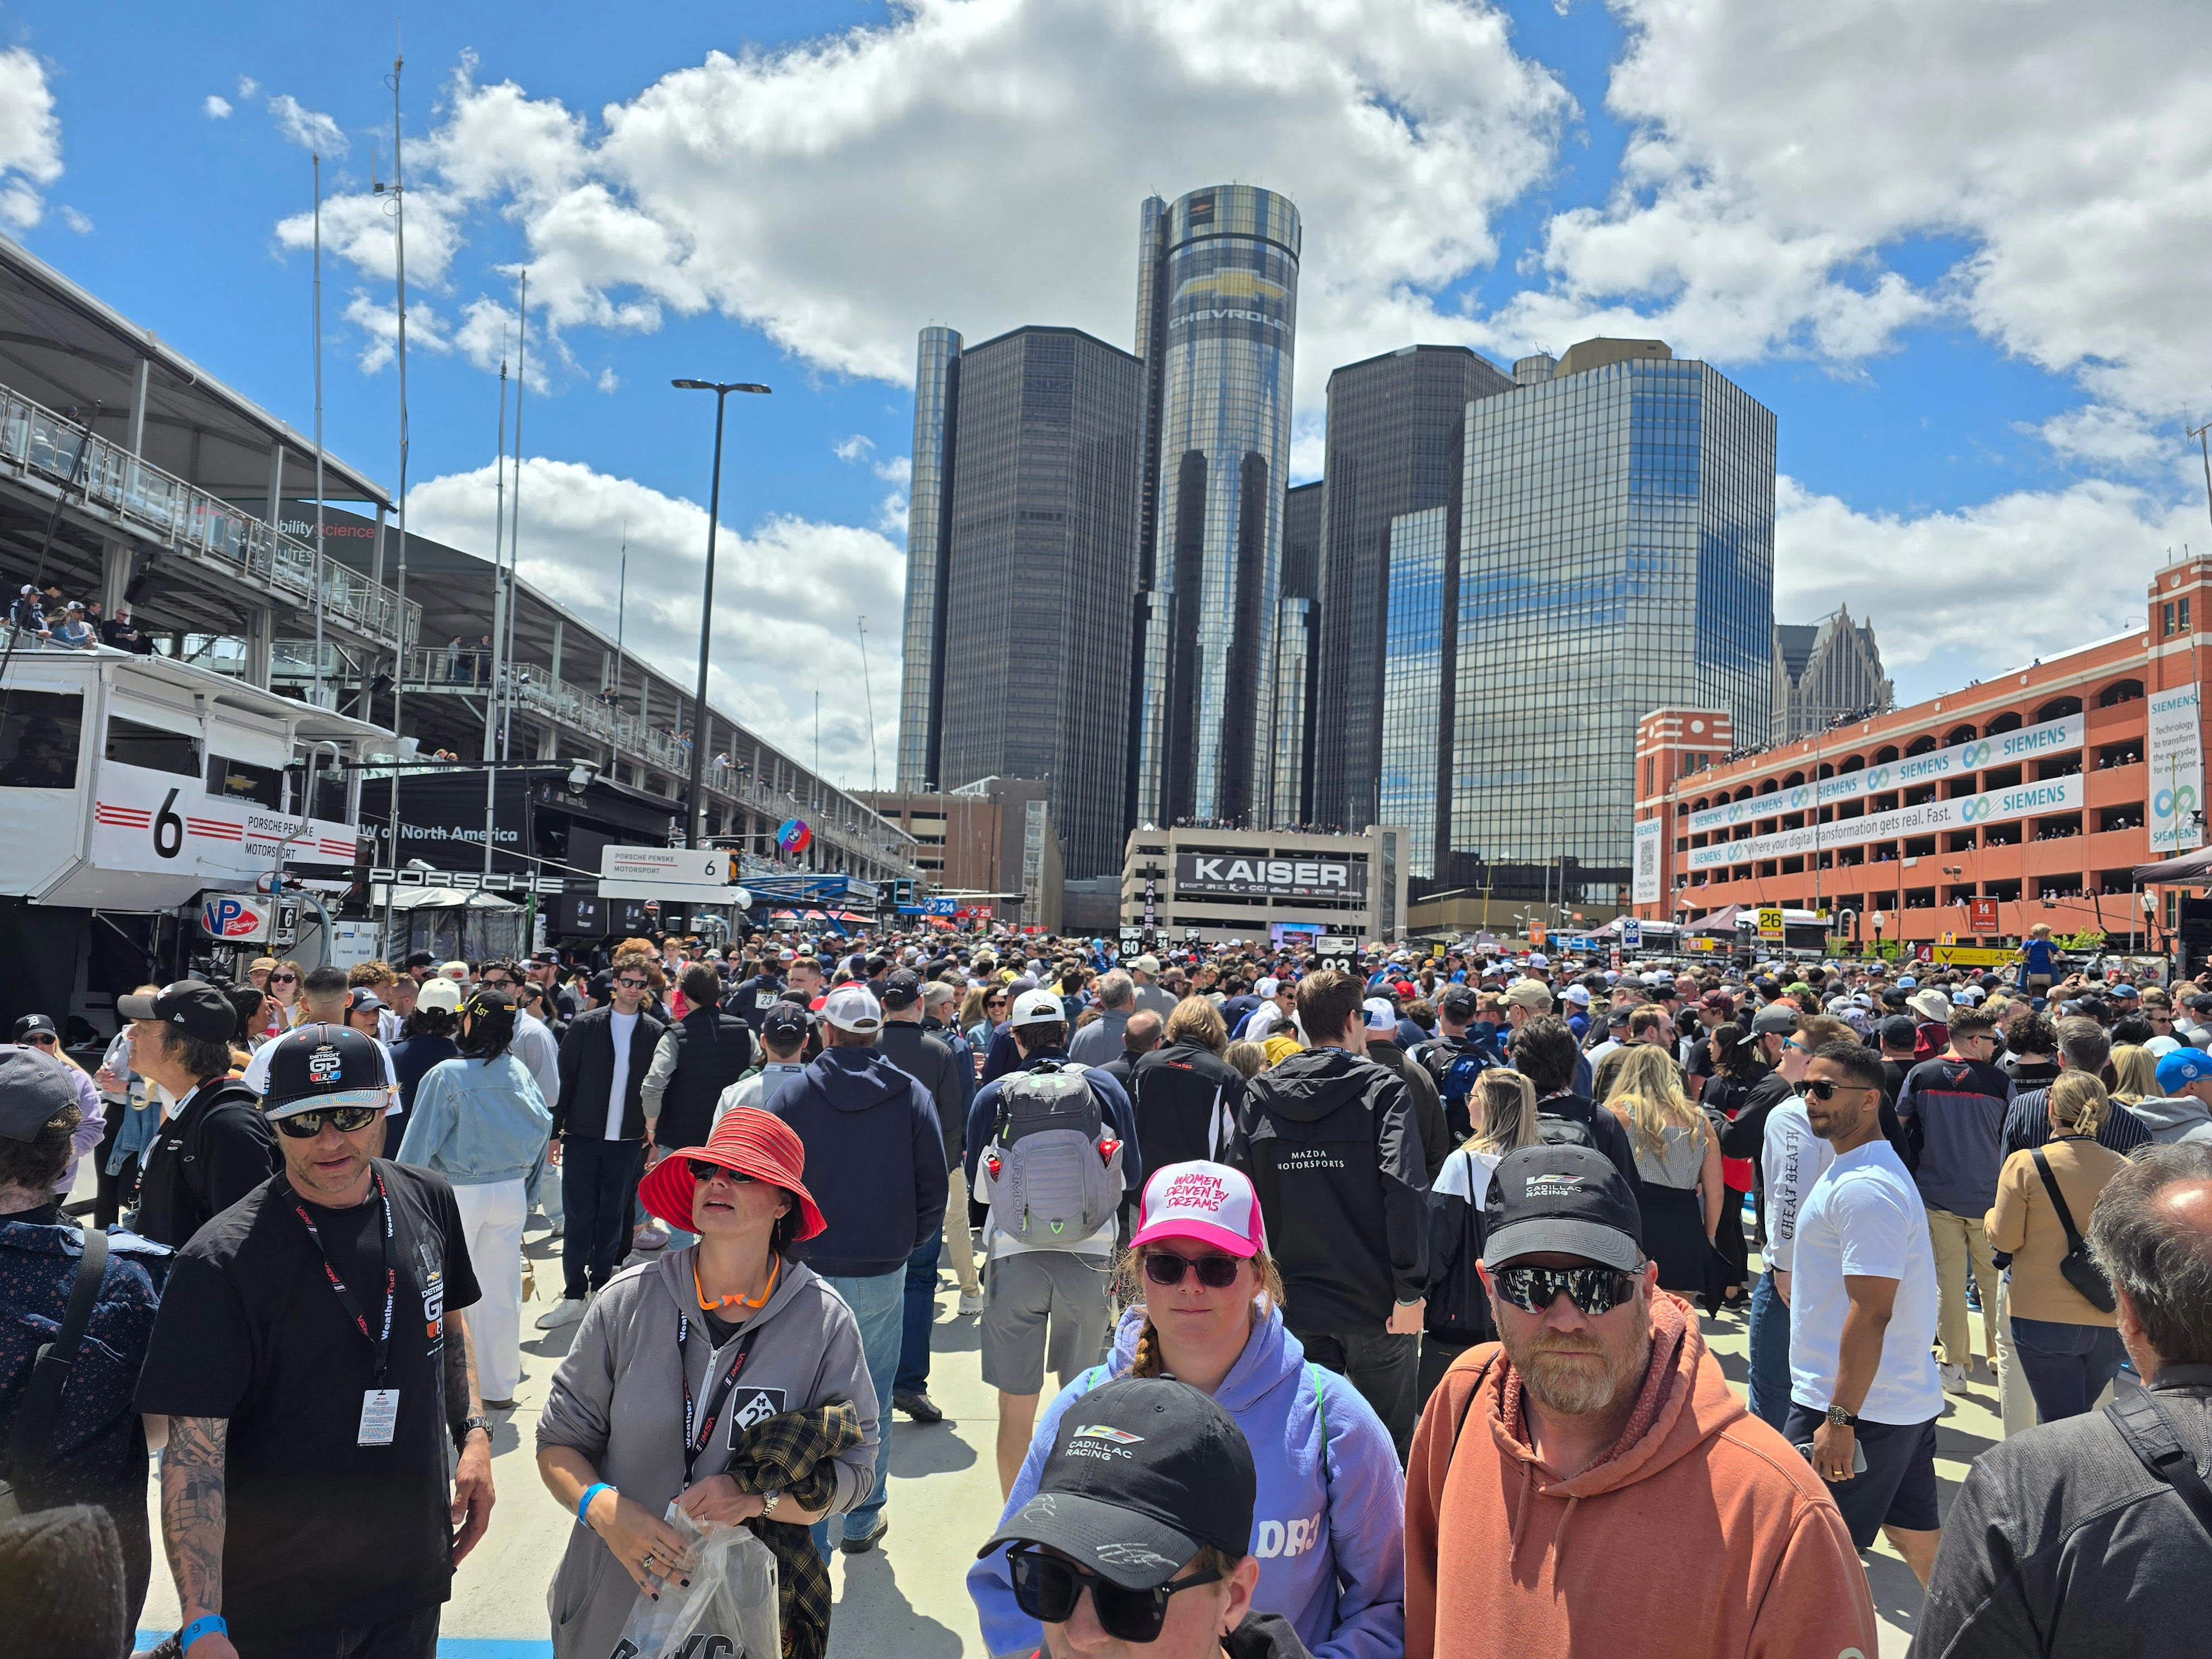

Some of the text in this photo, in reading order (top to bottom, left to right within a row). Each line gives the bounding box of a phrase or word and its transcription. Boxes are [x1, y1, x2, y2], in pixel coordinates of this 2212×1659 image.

[1169, 308, 1291, 335] CHEVROLET
[2152, 693, 2197, 715] SIEMENS
[2156, 720, 2194, 735] Technology
[2003, 726, 2066, 755] SIEMENS
[2154, 732, 2196, 749] to transform
[2153, 752, 2164, 762] the
[1900, 755, 1949, 780] SIEMENS
[2154, 764, 2163, 775] for
[1818, 778, 1857, 799] SIEMENS
[1750, 797, 1783, 815] SIEMENS
[153, 788, 182, 859] 6
[248, 816, 282, 832] PORSCHE
[1695, 811, 1722, 827] SIEMENS
[1695, 850, 1721, 864] SIEMENS
[1746, 841, 1770, 853] Where
[1772, 841, 1787, 854] your
[1789, 830, 1813, 850] digital
[1880, 816, 1900, 835] gets
[1902, 809, 1924, 828] real.
[1927, 806, 1951, 823] Fast.
[2003, 785, 2065, 811] SIEMENS
[401, 825, 447, 840] North
[450, 826, 518, 842] America
[1636, 822, 1659, 836] SIEMENS
[2153, 828, 2198, 843] SIEMENS
[245, 843, 296, 860] MOTORSORT
[614, 865, 661, 874] MOTORSPORT
[705, 860, 715, 875] 6
[1196, 858, 1347, 886] KAISER
[368, 867, 564, 894] PORSCHE
[939, 903, 954, 913] 24
[980, 909, 991, 917] 25
[1144, 880, 1155, 931] KAISER
[1978, 903, 1989, 914] 14
[205, 899, 242, 935] VP
[285, 908, 294, 928] 6
[1760, 913, 1781, 928] 26
[225, 920, 259, 933] Racing
[1625, 928, 1638, 938] 66
[1122, 941, 1139, 954] 60
[1157, 938, 1168, 948] 24
[1689, 940, 1701, 948] 81
[1921, 947, 1930, 961] 4
[761, 995, 773, 1005] 23
[474, 1002, 489, 1017] 1ST
[310, 1057, 340, 1072] GP
[1291, 1150, 1326, 1160] MAZDA
[1277, 1160, 1344, 1170] MOTORSPORTS
[1174, 1173, 1222, 1189] WOMEN
[1526, 1184, 1582, 1193] CADILLAC
[1781, 1131, 1799, 1240] CHEAT DEATH
[1013, 1149, 1027, 1237] ARMOUR
[1164, 1185, 1230, 1202] DRIVEN BY
[375, 1173, 393, 1238] WeatherTech
[1167, 1197, 1219, 1212] DREAMS
[295, 1205, 313, 1225] IMSA
[324, 1261, 339, 1282] IMSA
[421, 1282, 444, 1299] DETRO
[381, 1269, 395, 1340] WeatherTech
[424, 1290, 444, 1322] G
[357, 1314, 369, 1337] MSA
[731, 1352, 746, 1377] IMSA
[756, 1398, 766, 1406] M
[701, 1417, 715, 1444] IMSA
[1065, 1449, 1111, 1461] RACING
[1069, 1440, 1132, 1459] CADILLAC
